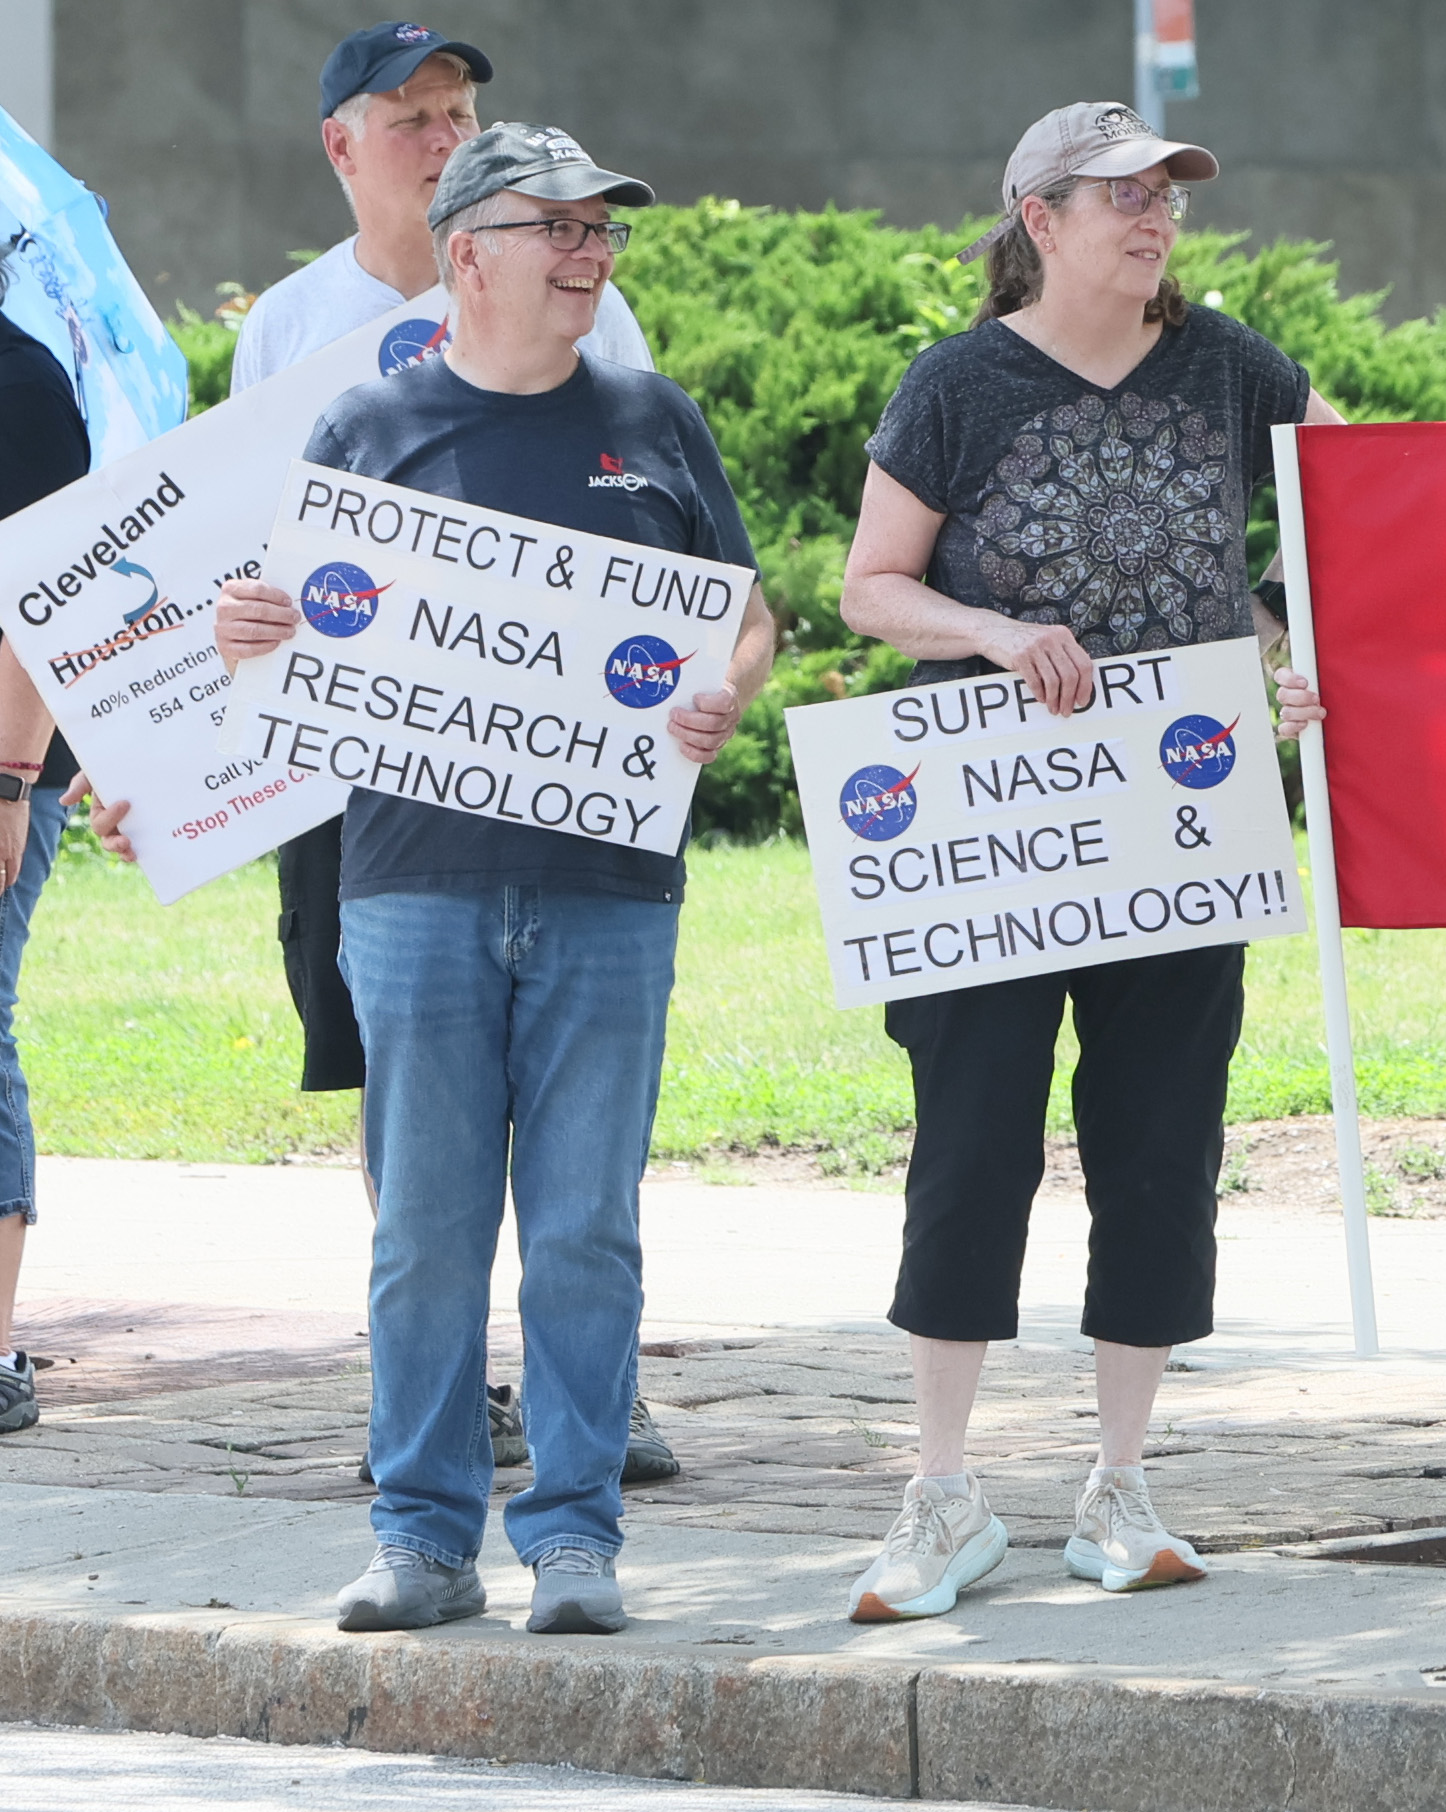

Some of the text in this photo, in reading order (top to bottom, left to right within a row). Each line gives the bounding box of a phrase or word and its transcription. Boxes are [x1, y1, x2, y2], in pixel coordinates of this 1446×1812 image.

[588, 473, 649, 492] JACKSON
[18, 471, 186, 627] Cleveland
[298, 479, 733, 622] PROTECT & FUND
[306, 586, 373, 617] NASA
[409, 598, 564, 677] NASA
[90, 645, 219, 719] 40% Reduction
[610, 658, 675, 687] NASA
[892, 656, 1171, 742] SUPPRT
[148, 697, 184, 725] 554
[282, 651, 657, 781] RESEARCH &
[204, 763, 242, 790] Call
[258, 713, 661, 844] TECHNOLOGY
[963, 743, 1126, 807] NASA
[1165, 740, 1233, 764] NASA
[227, 779, 288, 816] These
[845, 790, 914, 817] NASA
[849, 805, 1212, 900] SCIENCE &
[844, 870, 1288, 982] TECHNOLOGY!!
